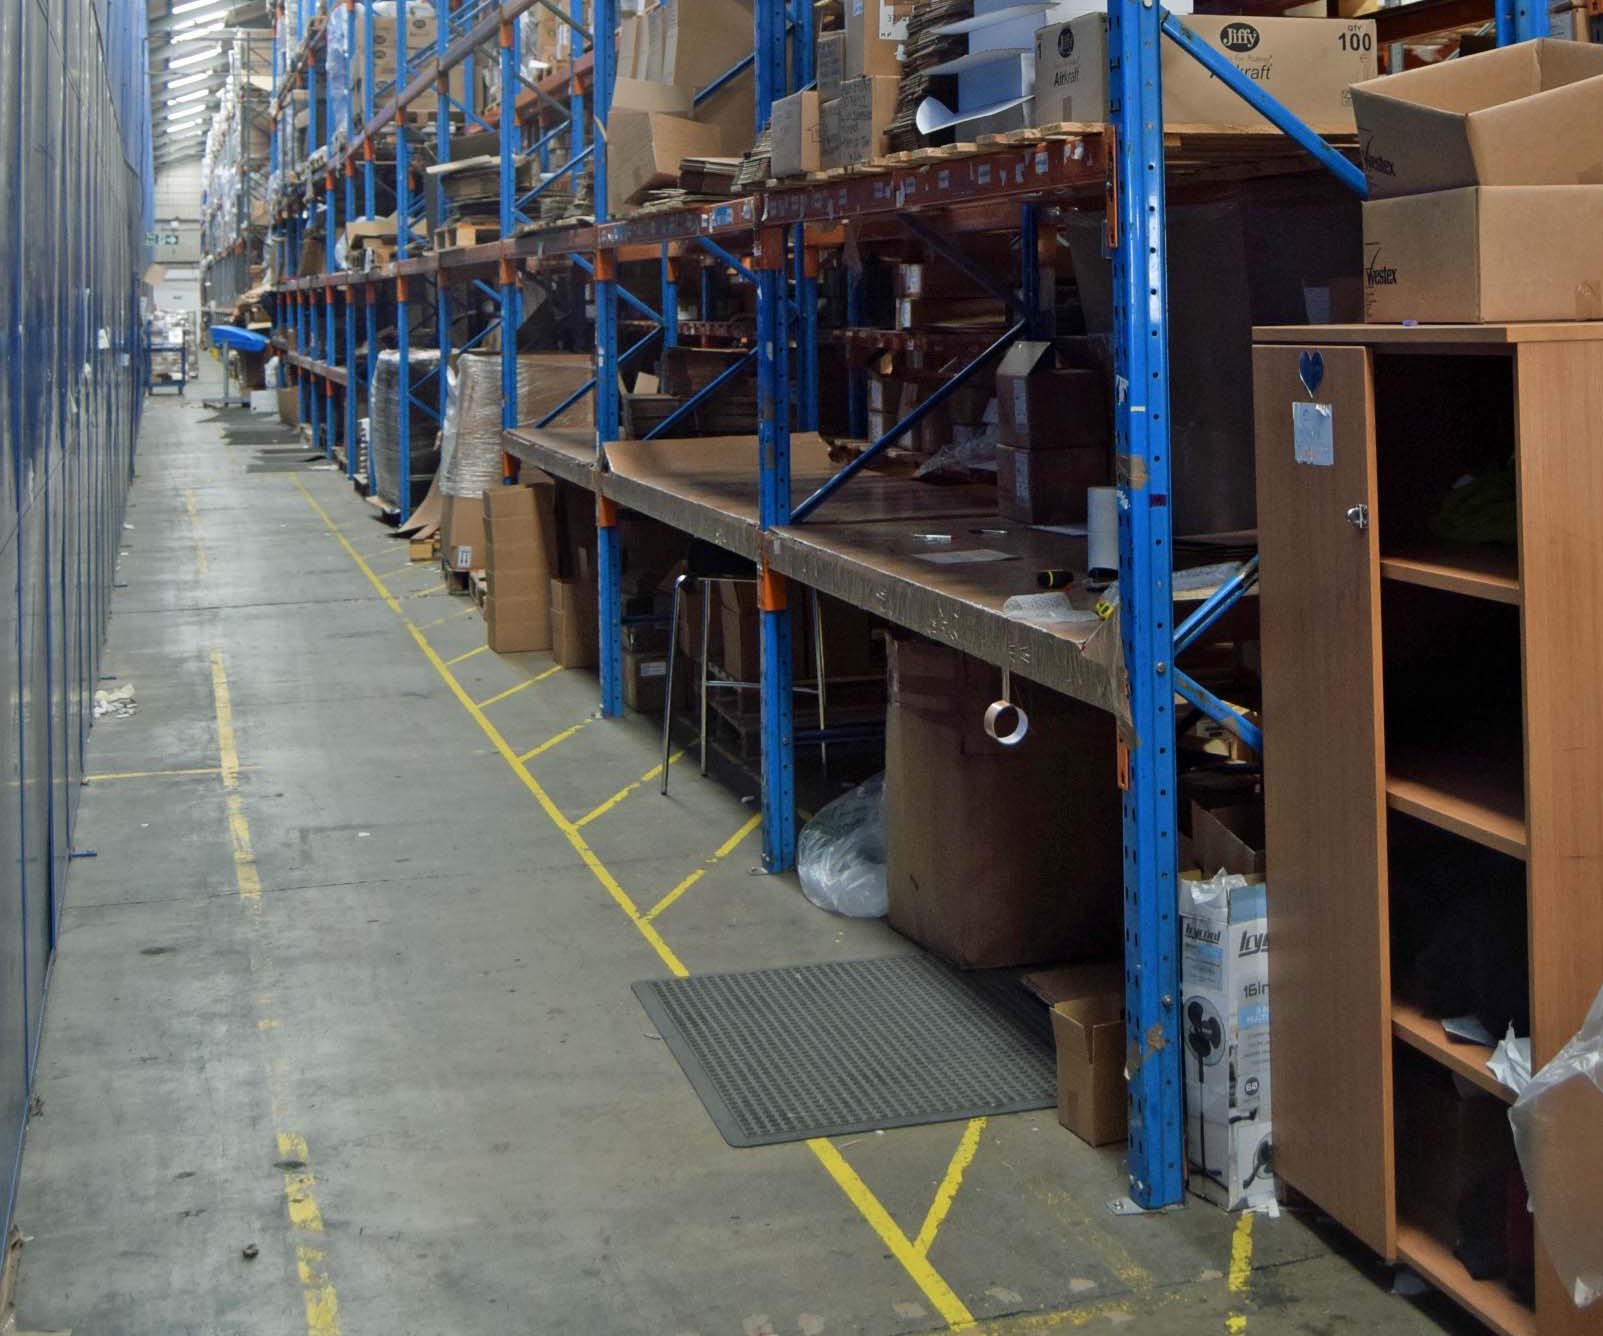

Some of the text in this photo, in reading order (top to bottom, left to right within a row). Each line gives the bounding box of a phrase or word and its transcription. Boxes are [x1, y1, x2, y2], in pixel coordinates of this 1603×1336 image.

[1222, 28, 1258, 48] Jiffy
[1347, 24, 1362, 32] QTY
[1338, 32, 1372, 52] 100
